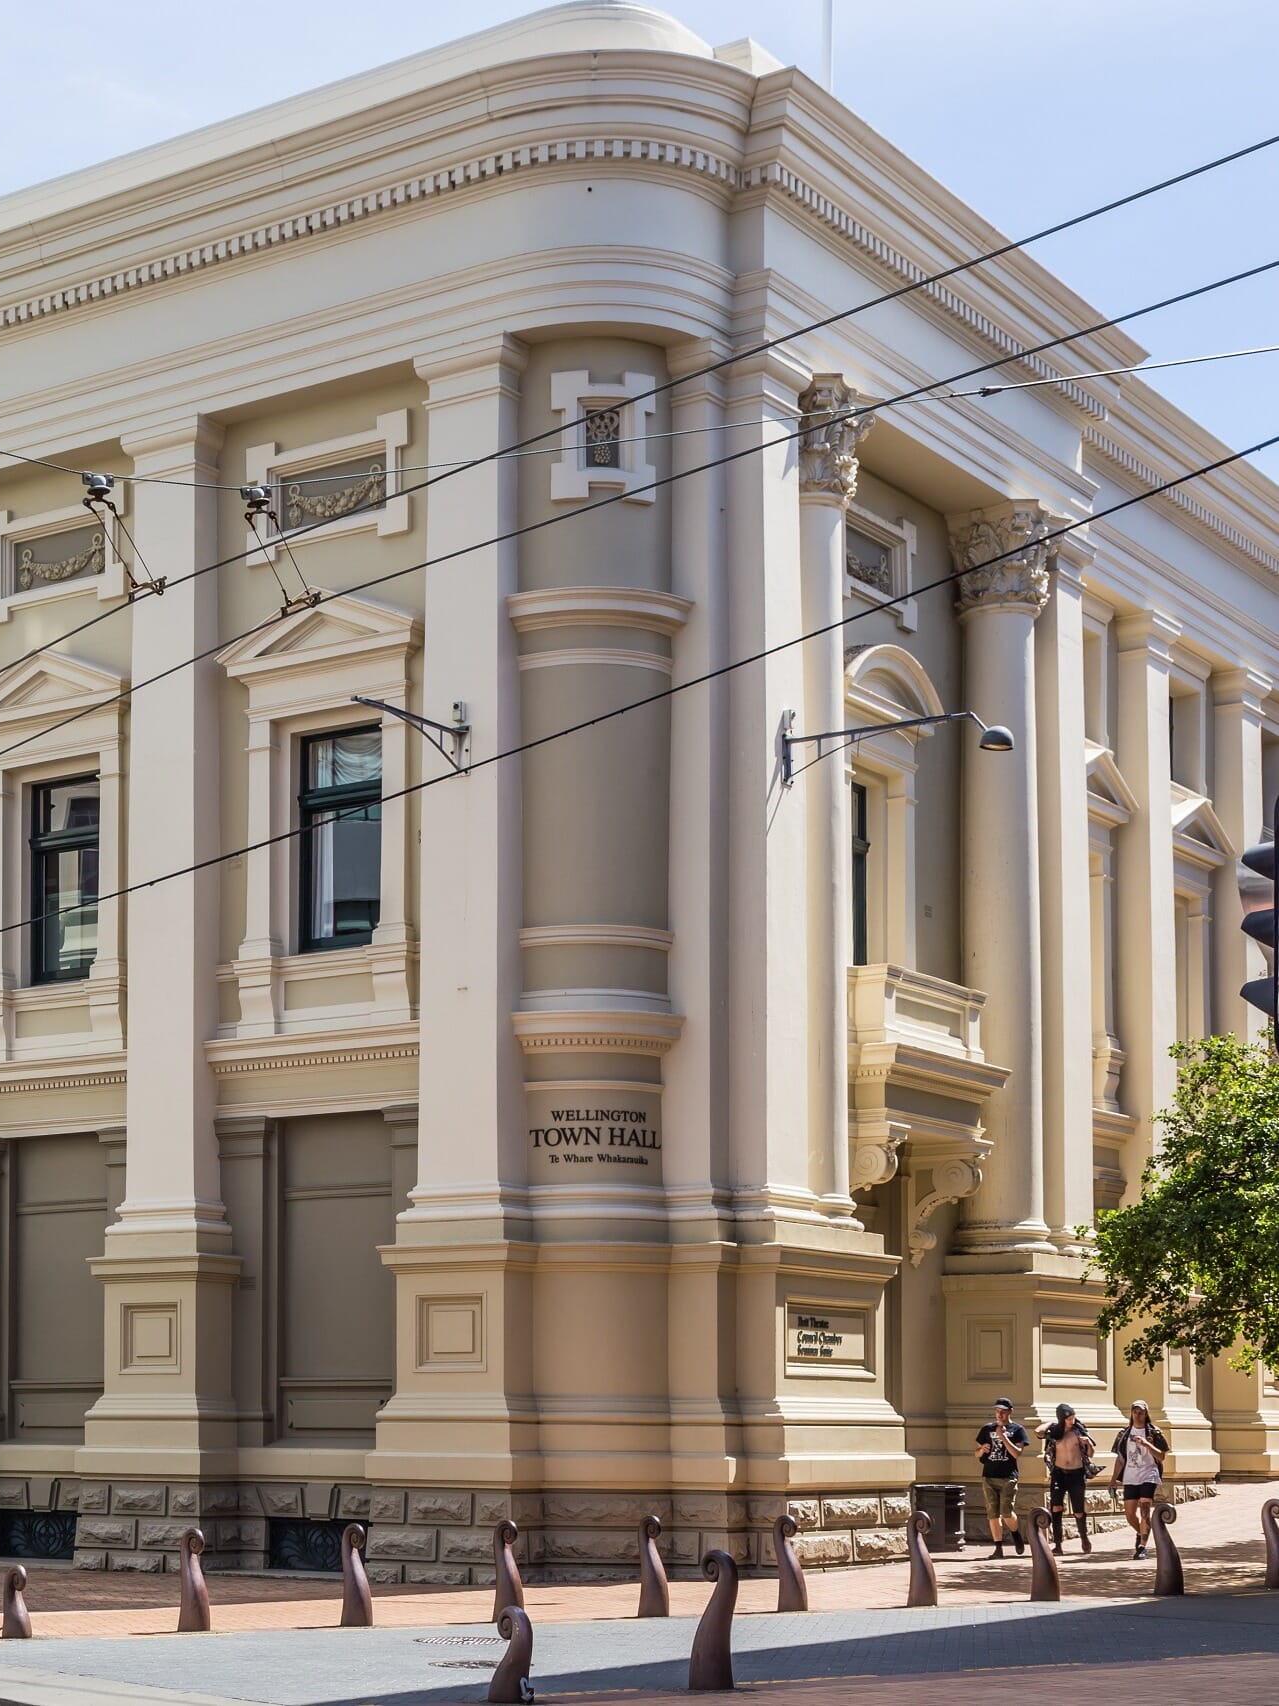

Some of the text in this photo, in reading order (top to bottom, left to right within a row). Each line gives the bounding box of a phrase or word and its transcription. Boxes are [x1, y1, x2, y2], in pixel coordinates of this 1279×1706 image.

[551, 1110, 647, 1124] WELLINGTON
[529, 1127, 662, 1150] TOWN HALL
[549, 1154, 560, 1164] Te
[563, 1154, 594, 1164] Whare
